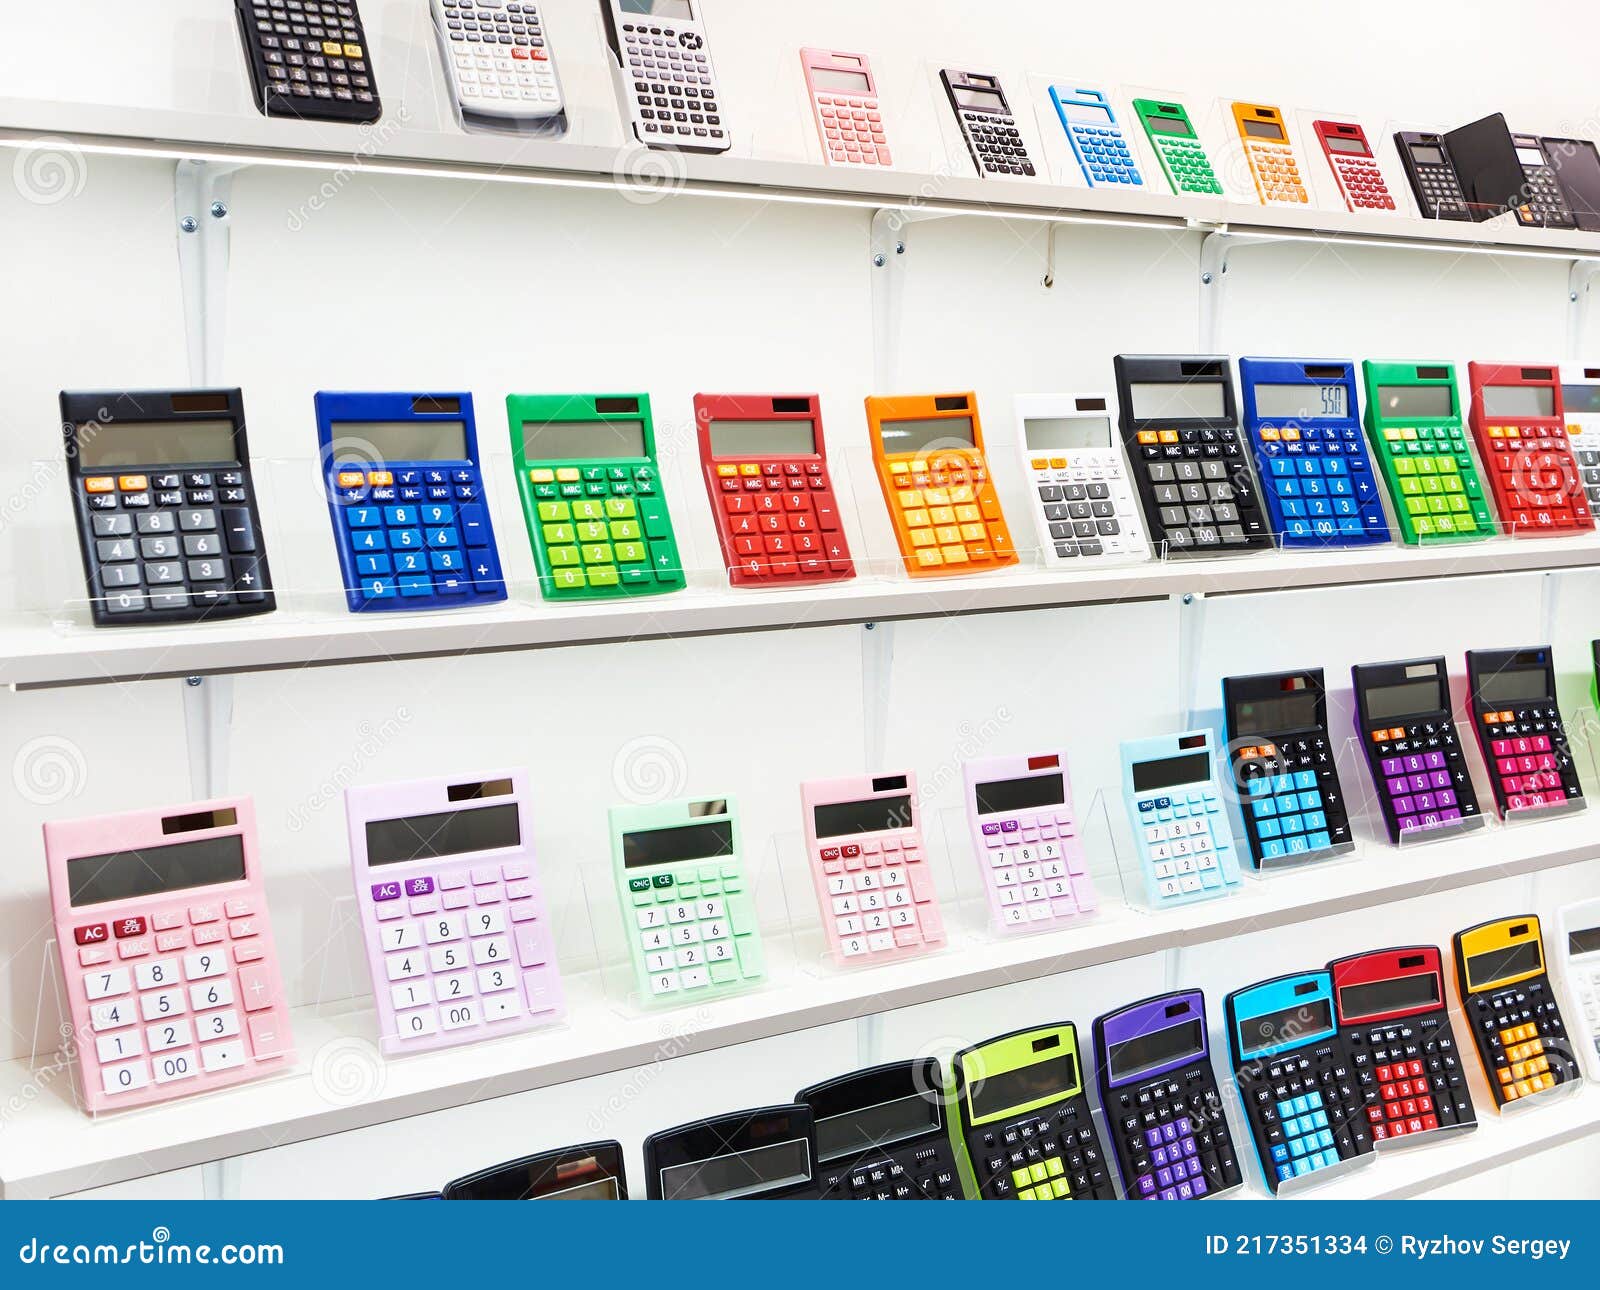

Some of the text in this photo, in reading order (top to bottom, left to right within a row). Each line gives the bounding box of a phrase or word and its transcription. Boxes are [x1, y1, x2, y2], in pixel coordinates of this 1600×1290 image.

[1158, 464, 1217, 477] 7 8 9
[1278, 461, 1338, 472] 7 8 9
[375, 490, 394, 498] MRC
[1049, 486, 1101, 497] 7 8 9
[1285, 481, 1344, 493] 4 5 6
[193, 492, 209, 500] M+
[735, 496, 799, 508] 7 8 9
[1290, 501, 1349, 513] 1 2 3
[107, 513, 201, 530] 7 8 9
[359, 508, 441, 522] 7 8 9
[742, 517, 805, 529] 4 5 6
[365, 531, 447, 546] 4 5 6
[746, 537, 810, 550] 1 2 3
[112, 538, 207, 556] 4 5 6
[370, 555, 451, 569] 1 2 3
[116, 564, 211, 581] 1 2 3
[374, 582, 383, 593] 0
[120, 595, 130, 607] 0
[1389, 755, 1437, 772] 7 8 9
[1397, 774, 1444, 791] 4 5 6
[659, 876, 669, 884] CE
[838, 872, 896, 889] 7 8 9
[380, 886, 396, 896] AC
[648, 904, 713, 923] 7 8 9
[84, 927, 103, 940] AC
[395, 915, 490, 944] 7 8 9
[654, 925, 718, 944] 4 5 6
[403, 943, 497, 973] 4 5 6
[658, 946, 723, 966] 1 2 3
[101, 956, 210, 991] 7 8 9
[408, 971, 502, 1002] 1 2 3
[110, 987, 218, 1022] 4 5 6
[412, 1007, 470, 1031] 0 00
[114, 1018, 224, 1054] 1 2 3
[119, 1058, 187, 1085] 0 00
